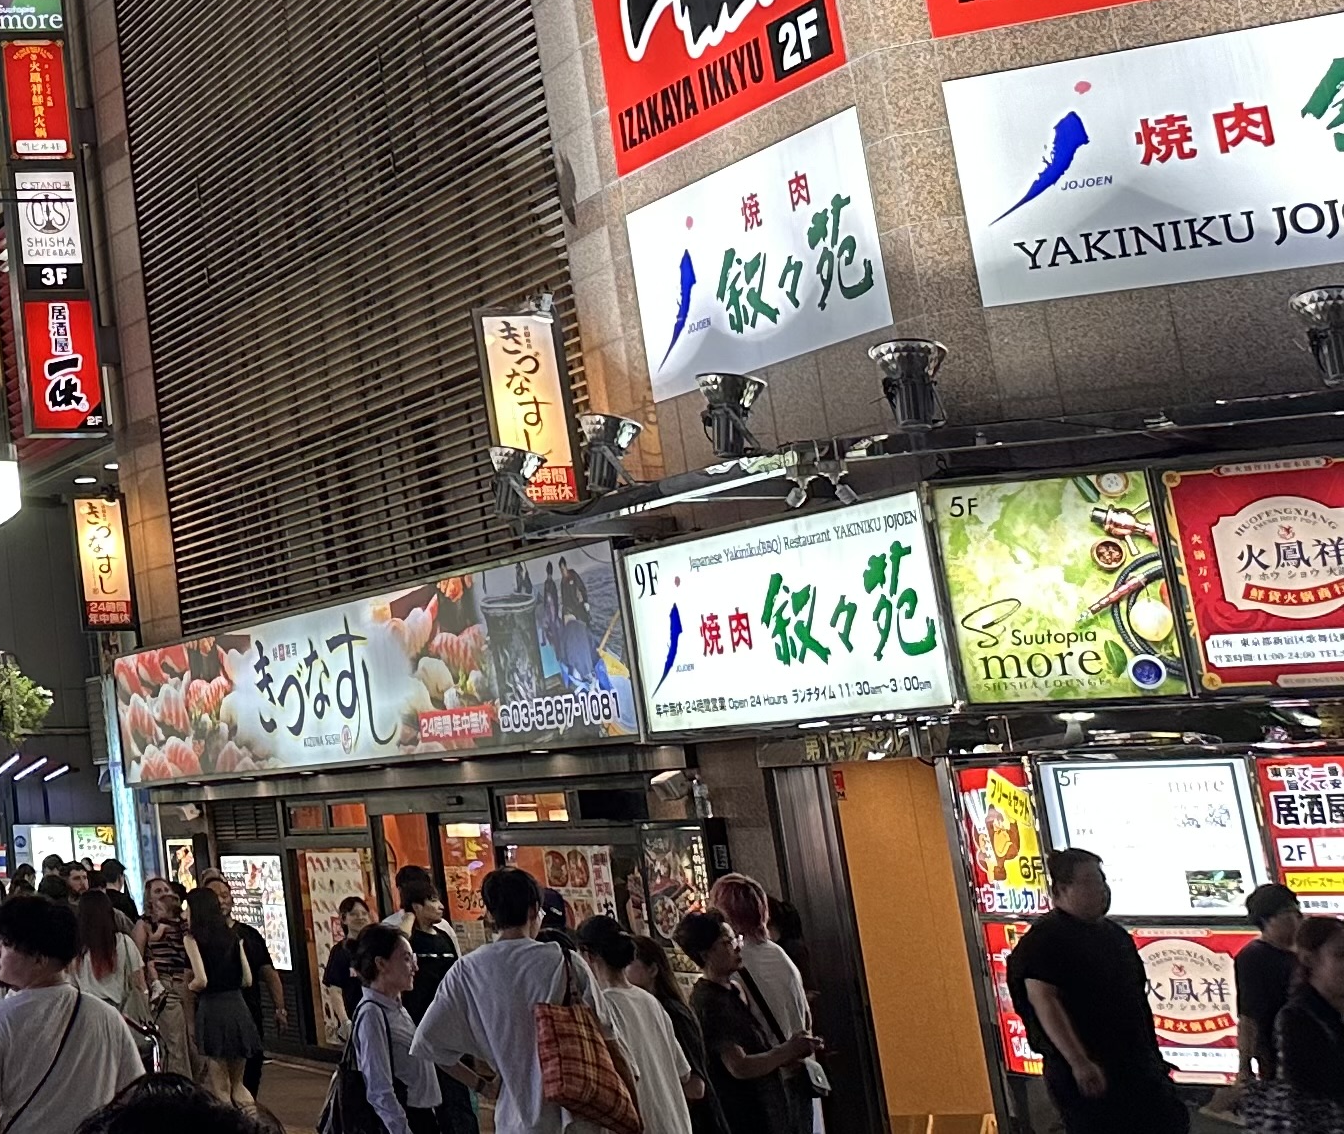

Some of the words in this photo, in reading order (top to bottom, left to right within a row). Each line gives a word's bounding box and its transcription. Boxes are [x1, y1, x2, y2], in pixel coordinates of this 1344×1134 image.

[777, 8, 820, 71] 2F
[617, 83, 697, 153] IZAKAYA
[701, 37, 765, 108] IKKYU
[1135, 102, 1276, 166] 焼肉
[1060, 174, 1113, 192] JOJOEN
[740, 170, 811, 232] 焼肉
[27, 237, 76, 248] SHISHA
[1014, 212, 1256, 271] YAKINIKU
[41, 268, 68, 286] 3F
[716, 193, 874, 334] 叙々苑
[51, 305, 71, 354] 居酒屋
[86, 416, 103, 427] 2F
[529, 467, 567, 483] 時間
[948, 495, 978, 518] 5F
[689, 553, 722, 572] Japanese
[784, 529, 832, 550] Restaurant
[833, 517, 882, 541] YAKINIKU
[883, 509, 919, 534] JOJOEN
[634, 560, 659, 600] 9F
[761, 540, 938, 666] 叙々苑
[699, 607, 753, 658] 焼肉
[1010, 626, 1098, 647] Suutopia
[981, 646, 1103, 681] more
[791, 686, 835, 704] ランチタイム
[983, 677, 1039, 694] SHISHA
[511, 692, 622, 732] 03-5287-1081
[1059, 770, 1080, 787] 5F
[1269, 766, 1340, 779] 東京で一番
[1019, 856, 1043, 880] 6F
[1283, 845, 1307, 862] 2F
